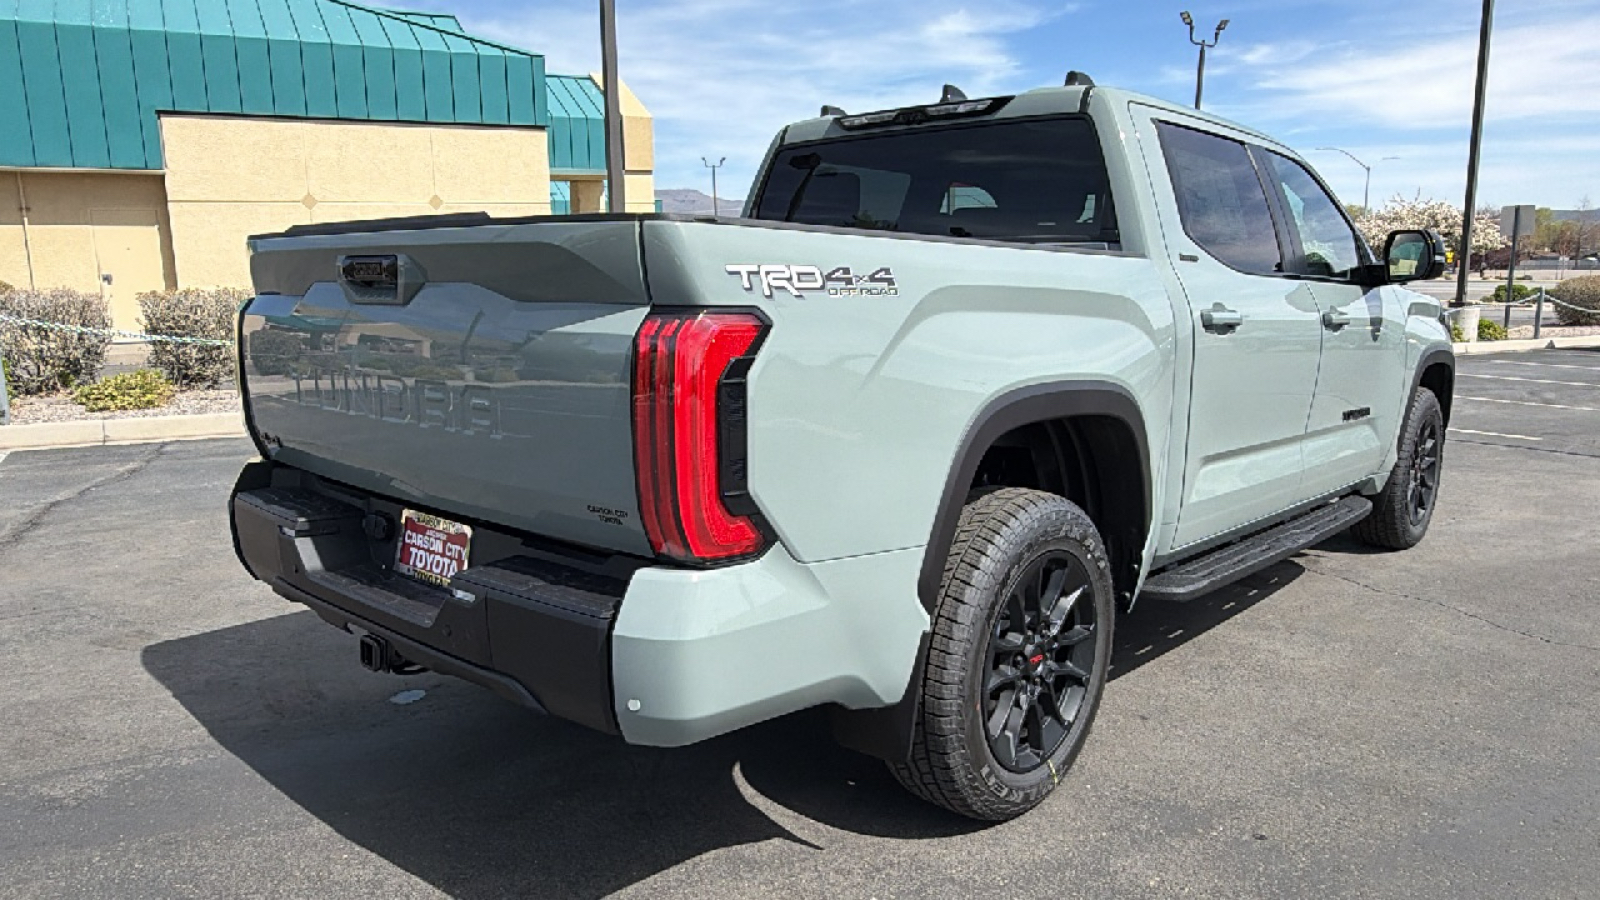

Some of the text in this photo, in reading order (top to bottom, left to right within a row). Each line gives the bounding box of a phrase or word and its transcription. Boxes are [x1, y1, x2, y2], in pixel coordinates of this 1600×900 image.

[725, 264, 825, 298] TRD
[828, 287, 900, 298] OFF ROAD
[405, 530, 443, 553] CARSON
[446, 542, 467, 560] CITY
[410, 547, 457, 578] TOYOTA
